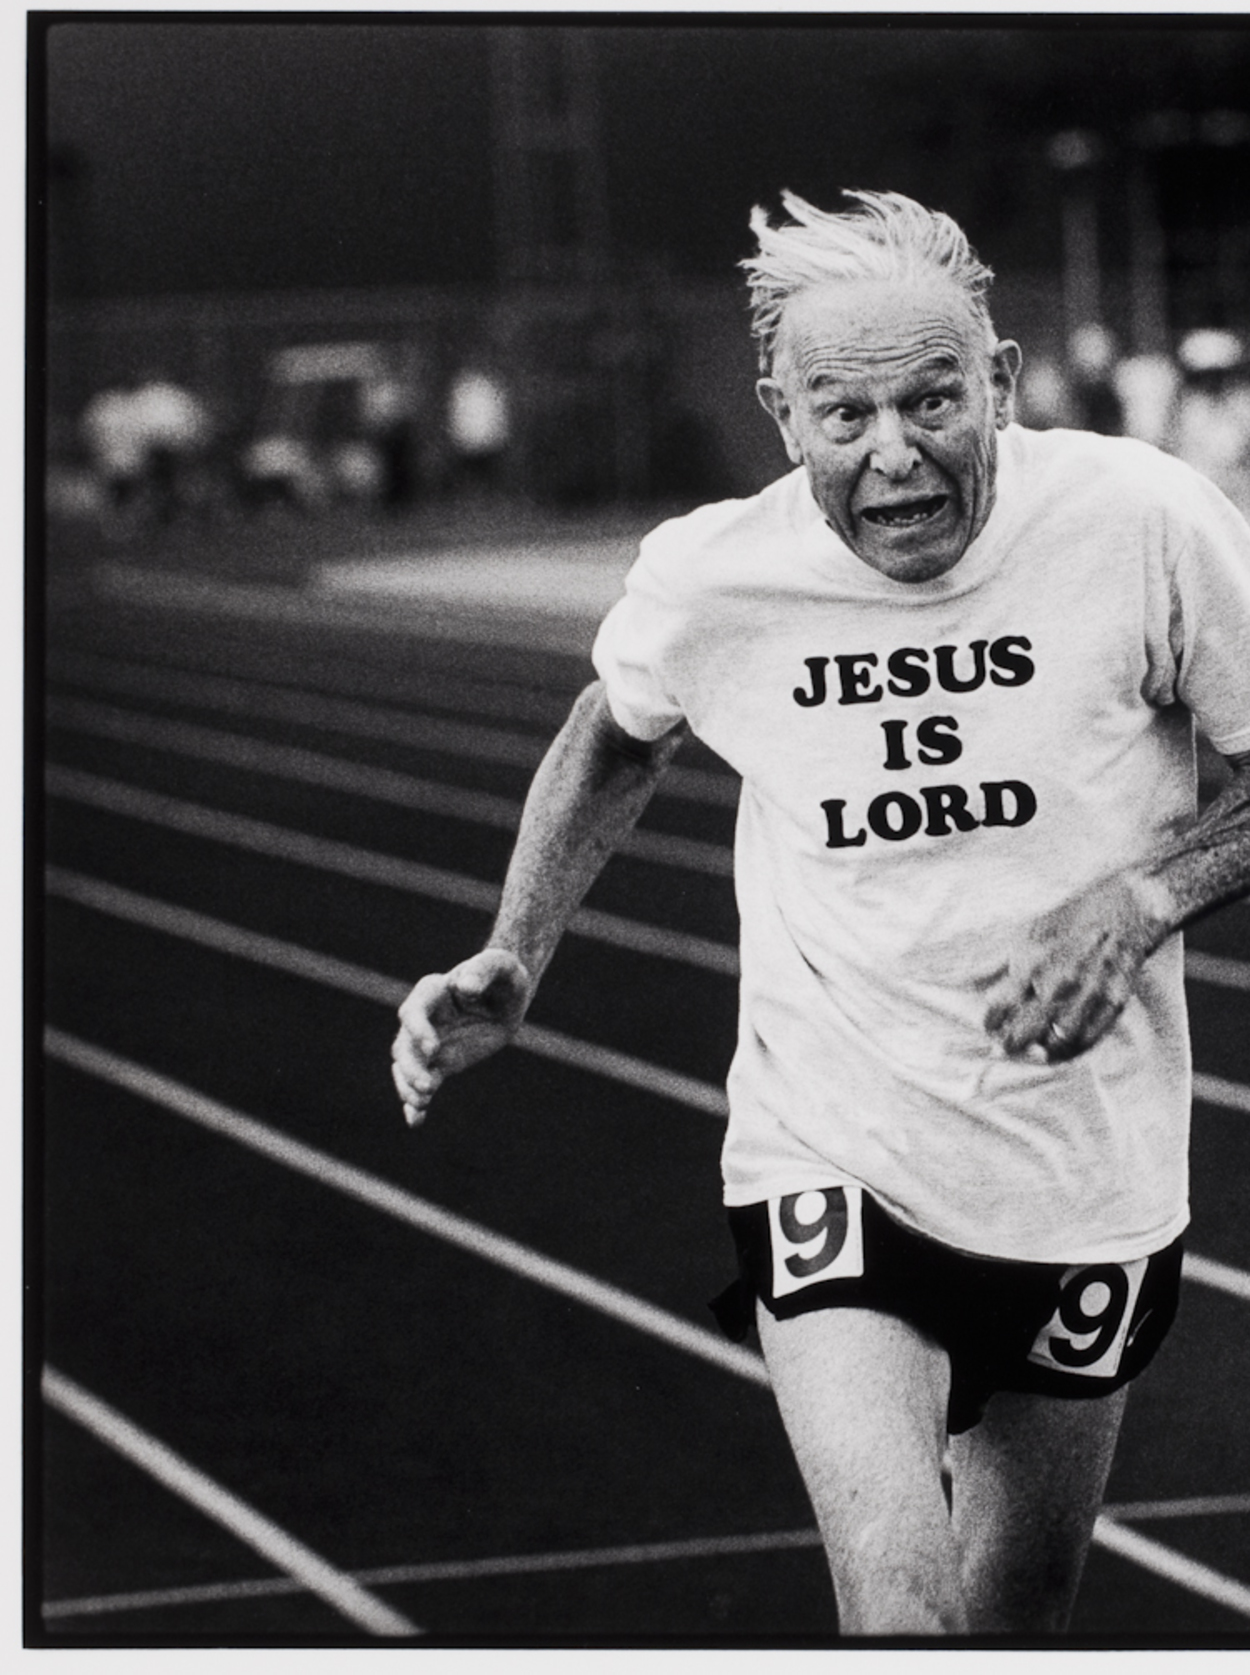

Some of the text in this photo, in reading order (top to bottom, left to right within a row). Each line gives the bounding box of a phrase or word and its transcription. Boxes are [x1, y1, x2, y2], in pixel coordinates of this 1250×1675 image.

[793, 635, 1035, 708] JESUS
[880, 715, 963, 771] IS
[820, 780, 1037, 849] LORD
[779, 1186, 848, 1278] 9
[1049, 1263, 1129, 1367] 9
